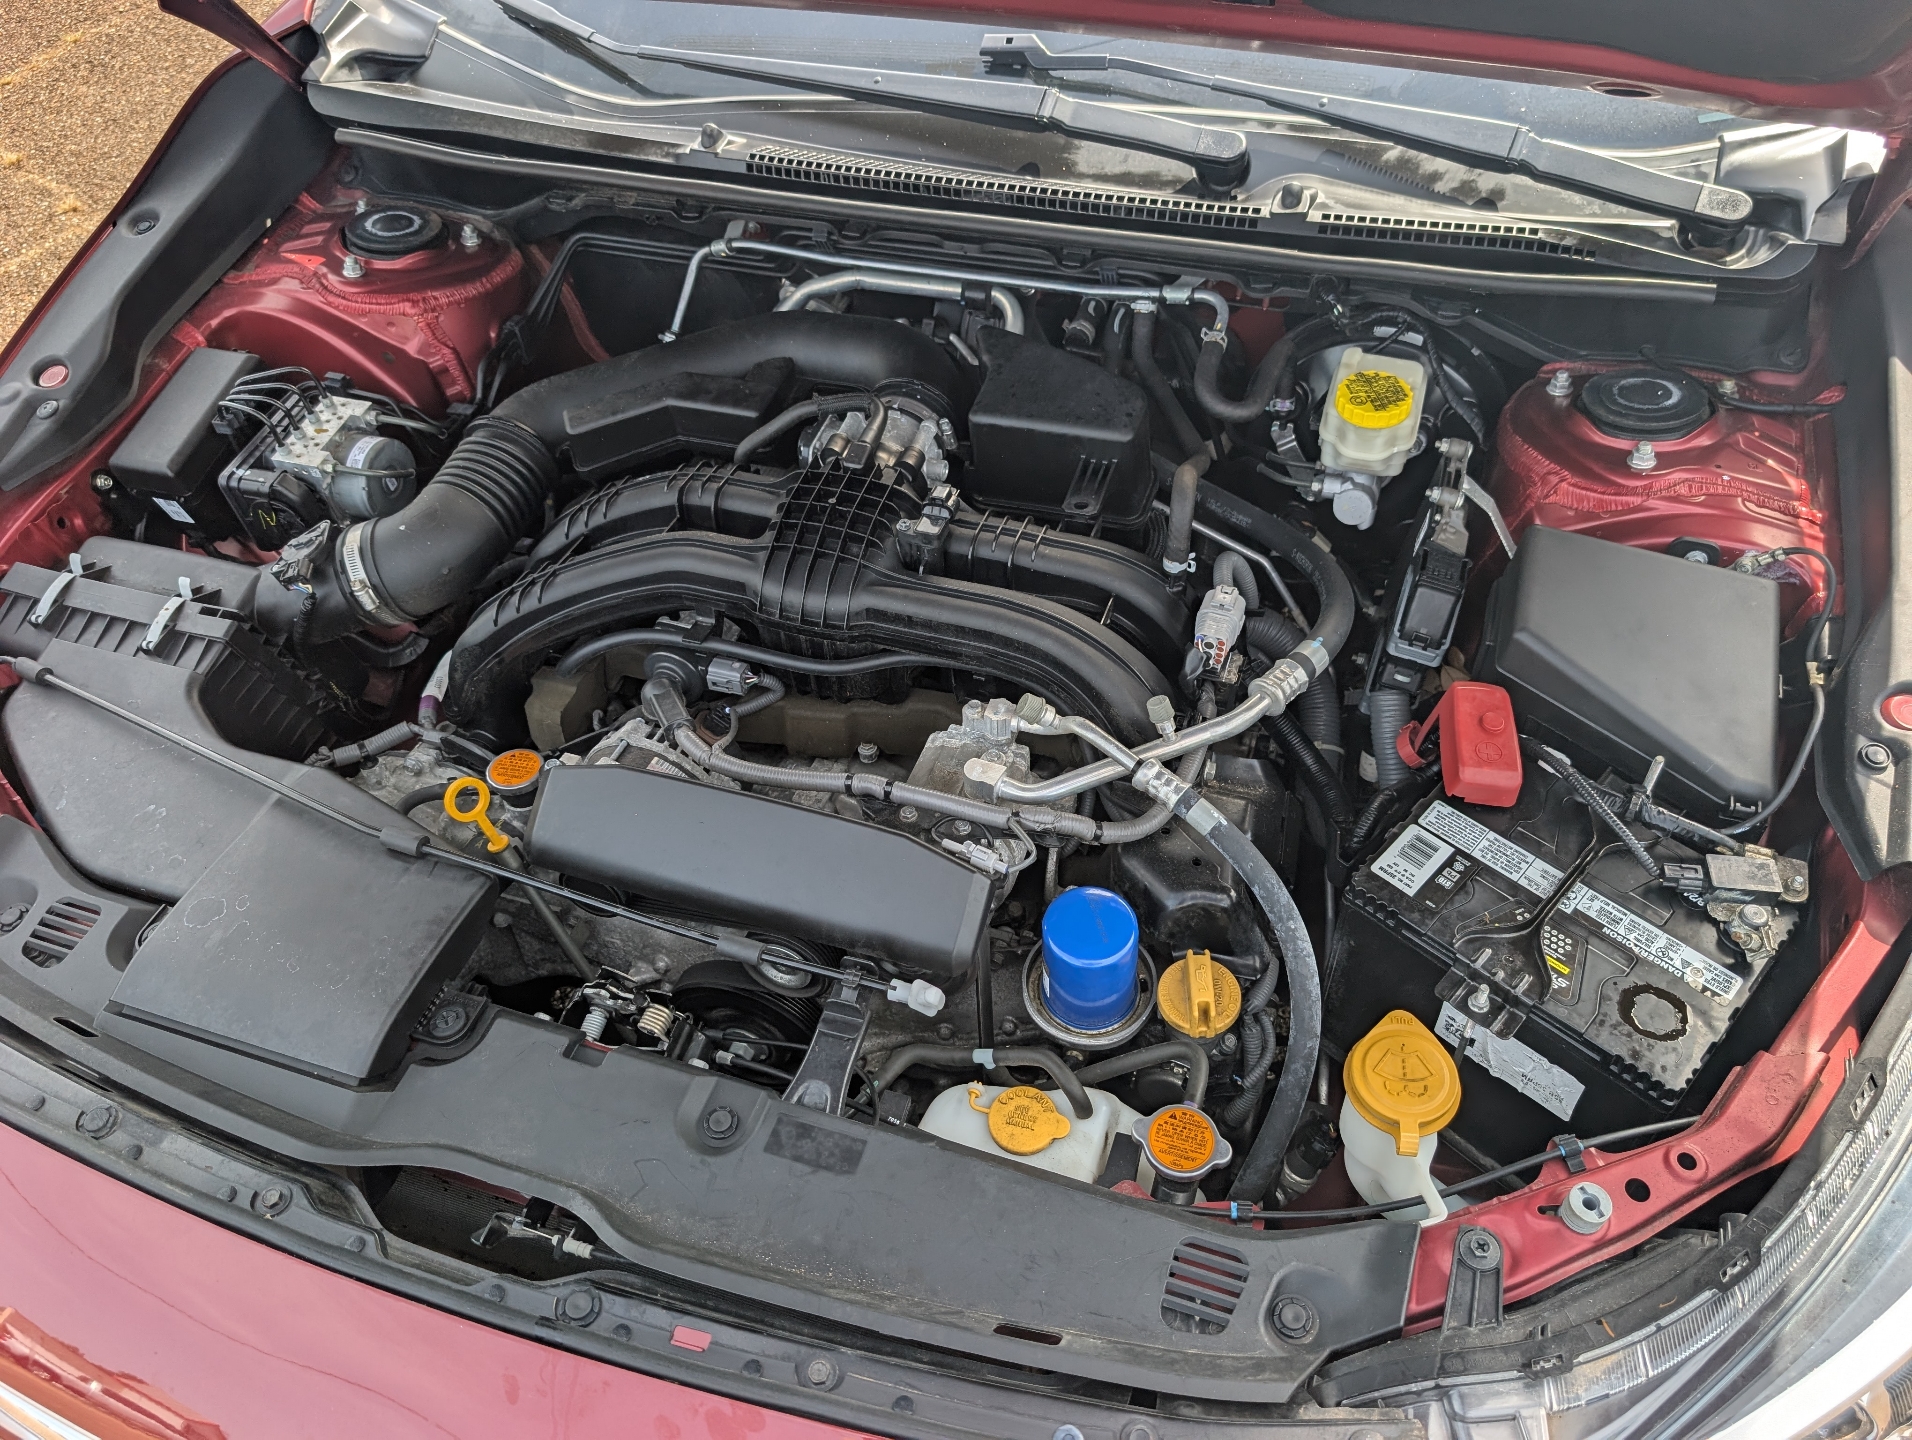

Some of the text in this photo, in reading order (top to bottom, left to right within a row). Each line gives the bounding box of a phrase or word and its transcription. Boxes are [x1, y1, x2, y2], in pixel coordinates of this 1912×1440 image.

[1446, 870, 1457, 879] Pb
[1601, 926, 1683, 978] DANGER/POISON
[1213, 978, 1223, 1006] 0W-20
[1218, 967, 1238, 1018] ENGINE OIL
[1163, 999, 1185, 1022] MANUAL
[1389, 1016, 1414, 1026] PULL
[998, 1088, 1054, 1114] COOLANT
